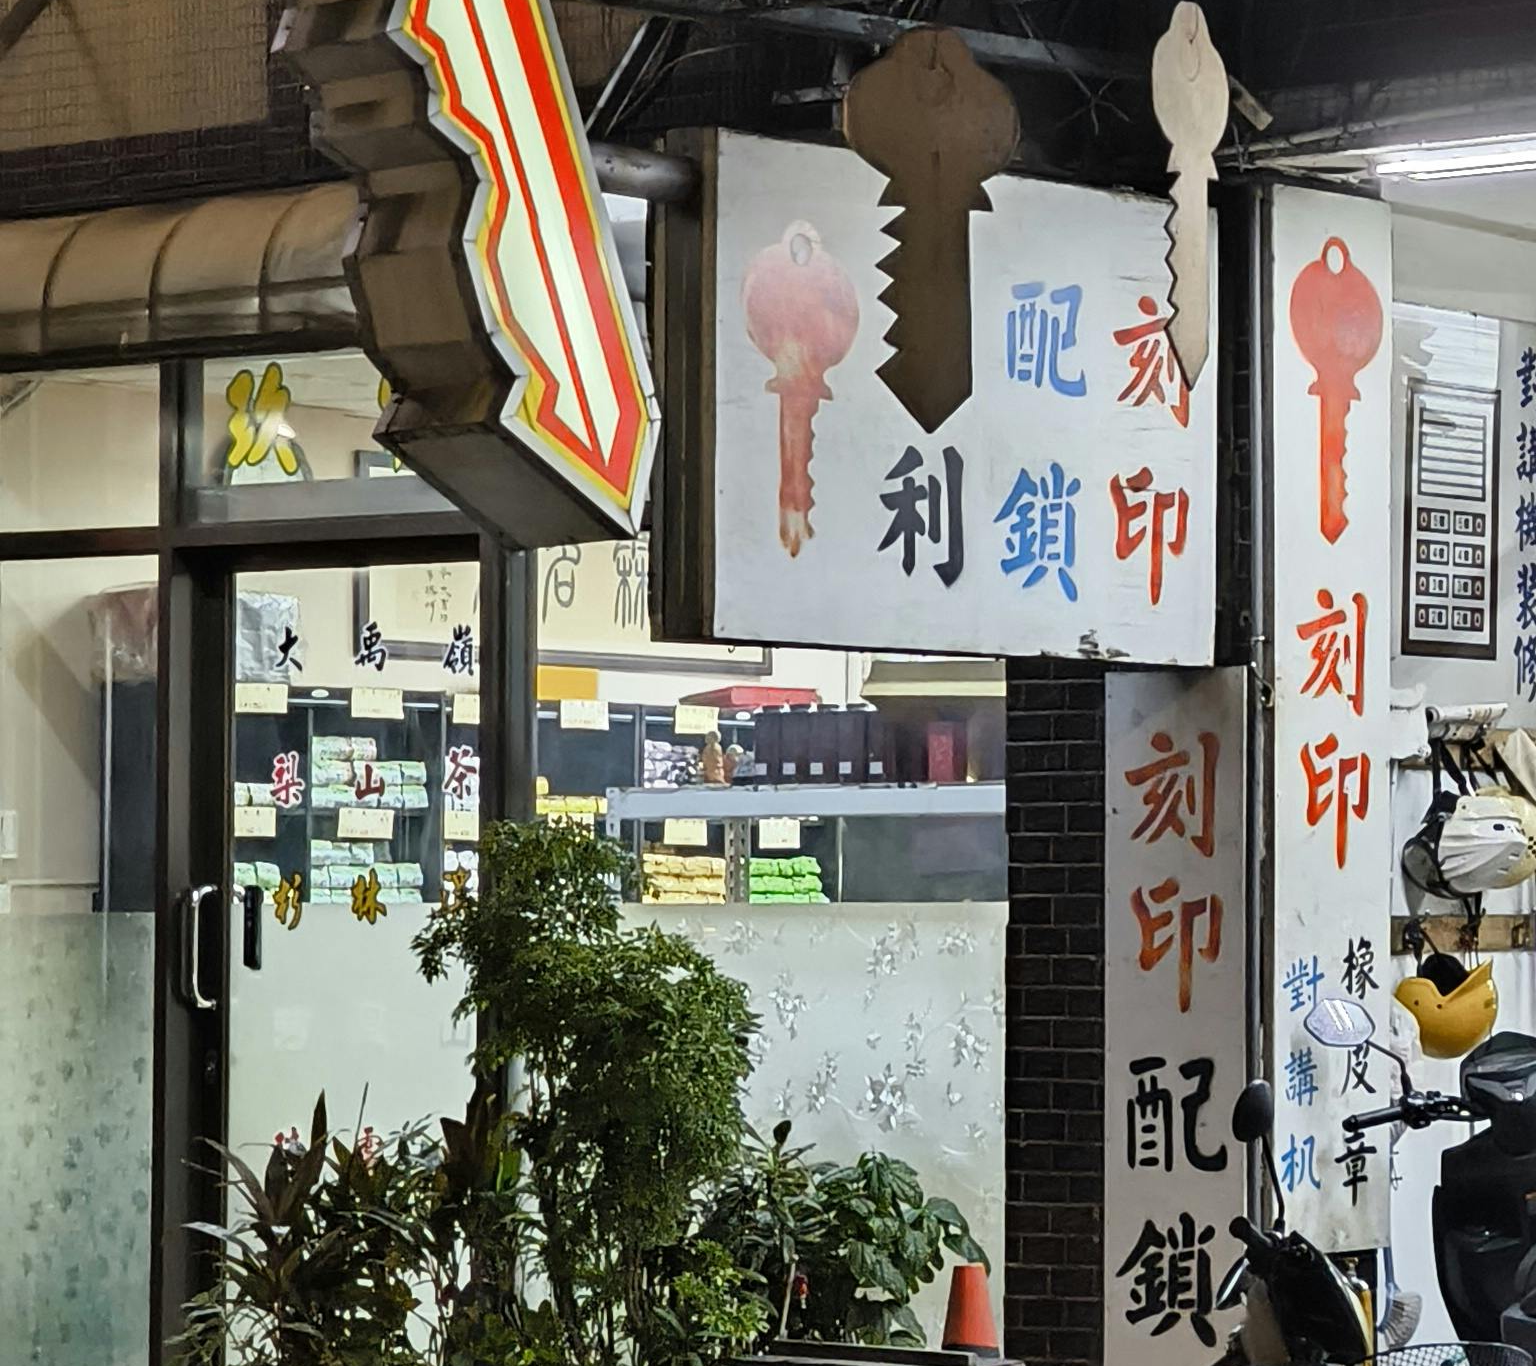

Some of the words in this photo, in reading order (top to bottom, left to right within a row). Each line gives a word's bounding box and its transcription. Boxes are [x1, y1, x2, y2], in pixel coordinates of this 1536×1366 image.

[877, 444, 966, 589] 利
[993, 281, 1087, 603] 配鎖
[1109, 295, 1190, 606] 刻印
[271, 746, 478, 808] 梨山茶
[276, 621, 475, 676] 大禹嶺
[1296, 588, 1372, 872] 刻印
[1124, 730, 1221, 1014] 刻印
[1116, 1056, 1229, 1348] 配鎖
